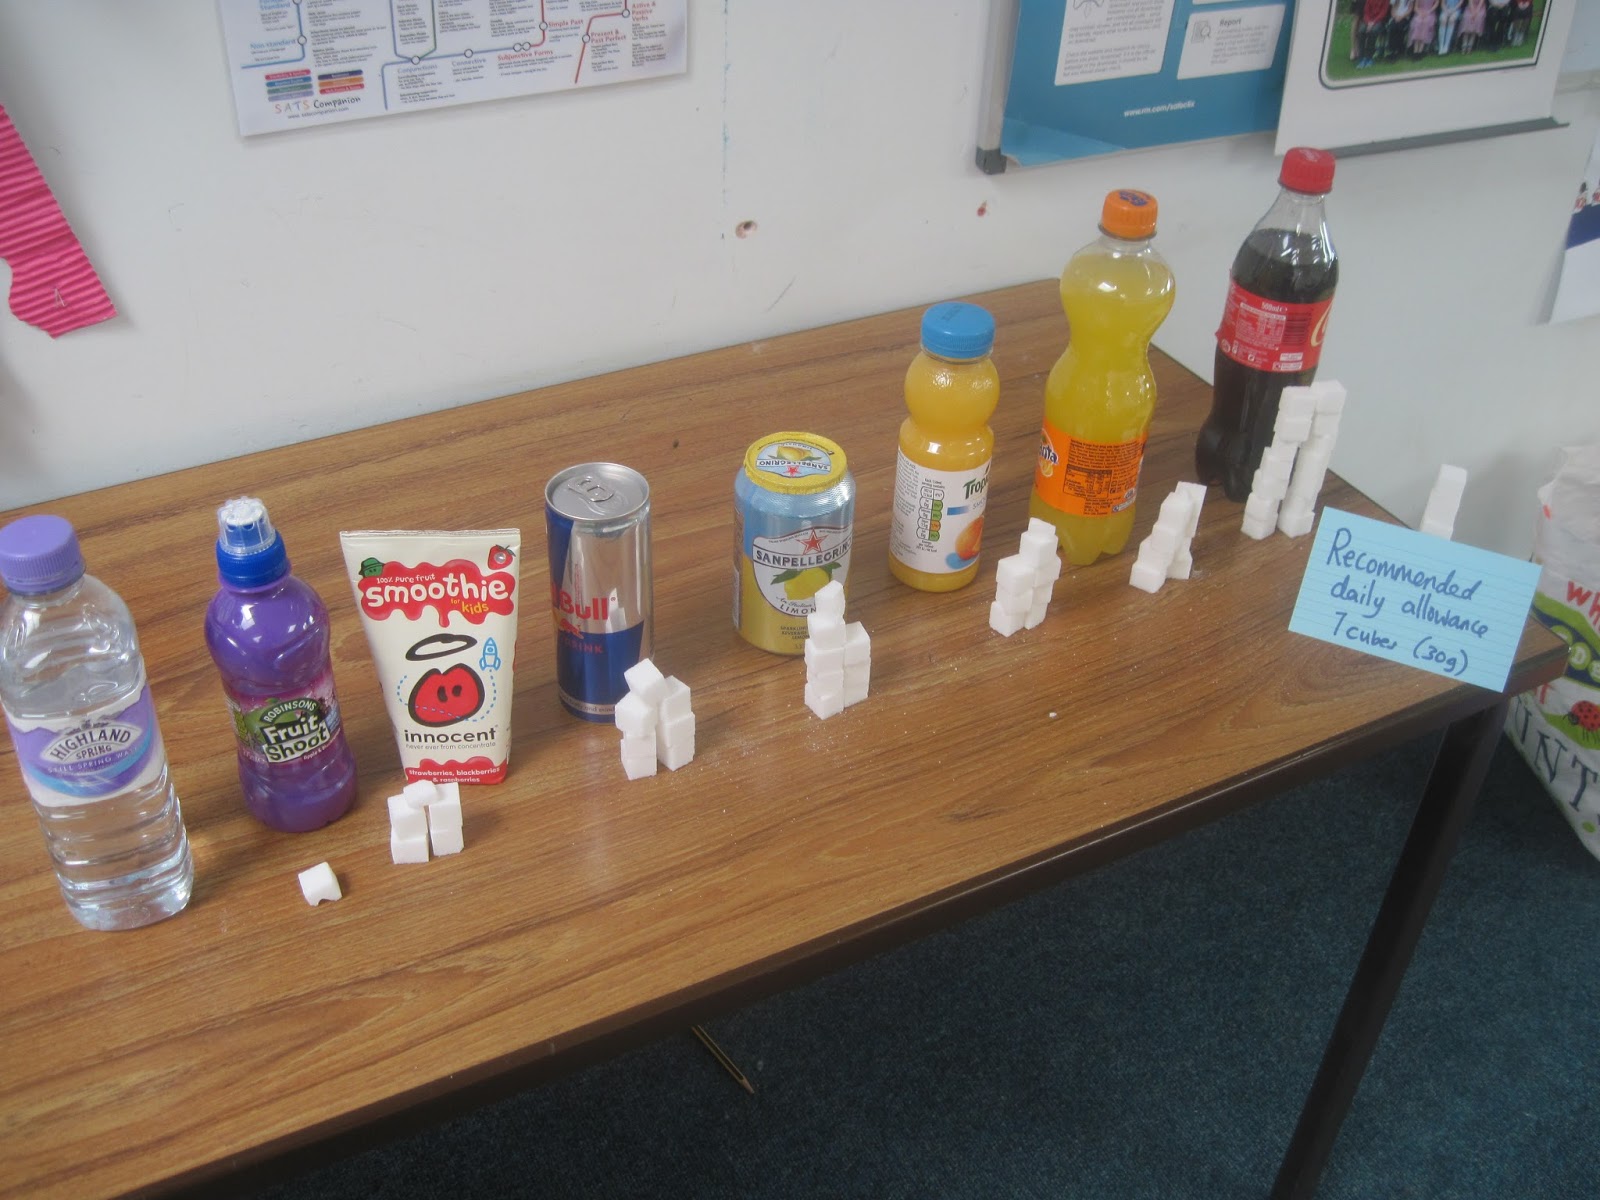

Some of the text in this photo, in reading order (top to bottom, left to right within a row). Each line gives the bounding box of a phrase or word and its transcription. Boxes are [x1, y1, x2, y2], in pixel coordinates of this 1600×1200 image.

[1220, 18, 1242, 28] Report
[313, 95, 362, 109] Companion
[1326, 527, 1482, 601] Recommended
[416, 573, 436, 582] fruit
[366, 573, 509, 608] smoothie
[461, 601, 489, 615] kids
[1330, 574, 1489, 638] daily allowance
[1333, 611, 1469, 677] 7 cubes (30g)
[263, 699, 317, 723] ROBINSONS
[263, 714, 318, 745] Fruit
[404, 727, 497, 743] innocent
[50, 728, 131, 761] HIGHLAND
[264, 721, 328, 762] Shoot
[457, 741, 496, 750] concentrate
[76, 745, 112, 760] SPRING
[79, 756, 112, 769] SPRING
[409, 767, 500, 777] strawberries, blackberries
